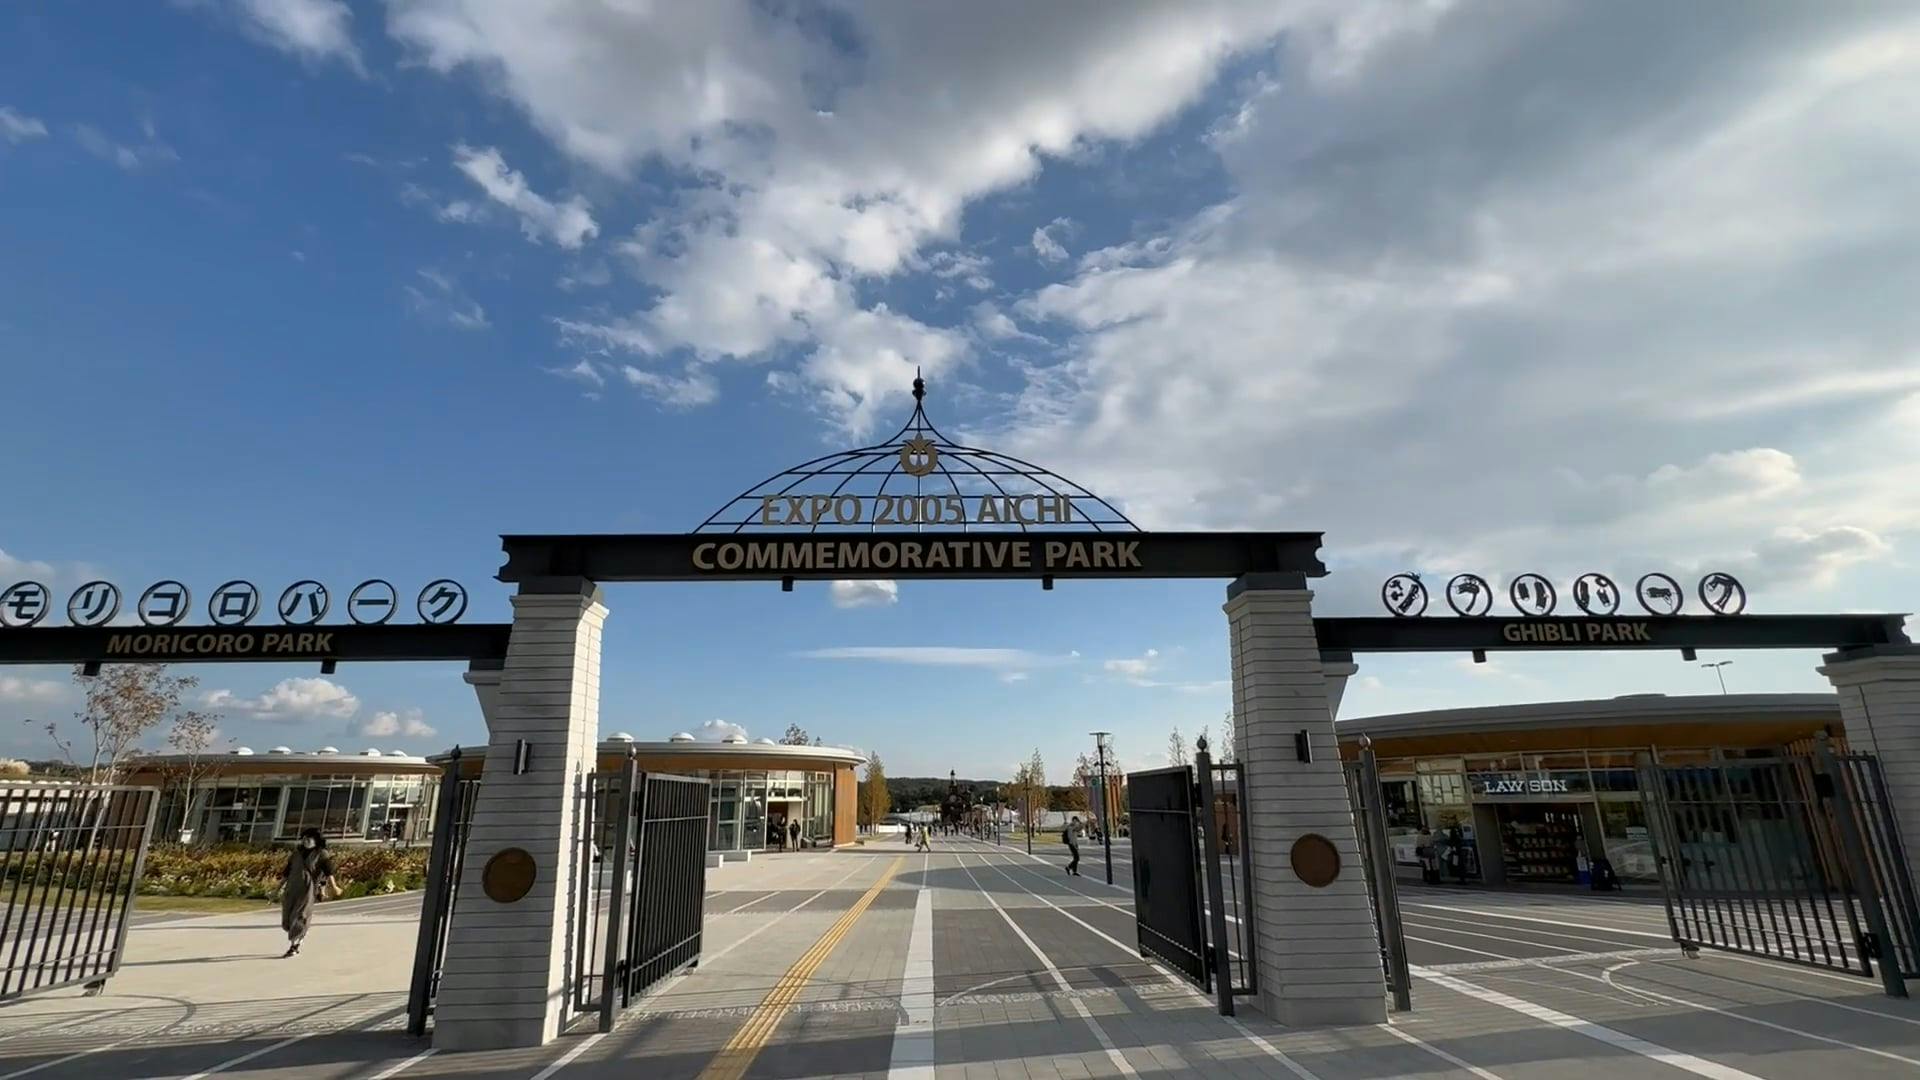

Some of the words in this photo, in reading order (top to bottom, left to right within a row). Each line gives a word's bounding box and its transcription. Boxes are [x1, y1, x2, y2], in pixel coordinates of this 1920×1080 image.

[762, 495, 861, 524] EXPO
[875, 495, 963, 524] 2005
[977, 494, 1072, 524] AICHI
[692, 542, 1031, 570] COMMEMORATIVE
[1045, 541, 1142, 568] PARK
[4, 581, 465, 623] モリコロパーク
[107, 633, 254, 655] MORICORO
[262, 632, 333, 653] PARK
[1503, 623, 1580, 643] GHIBLI
[1588, 623, 1651, 642] PARK
